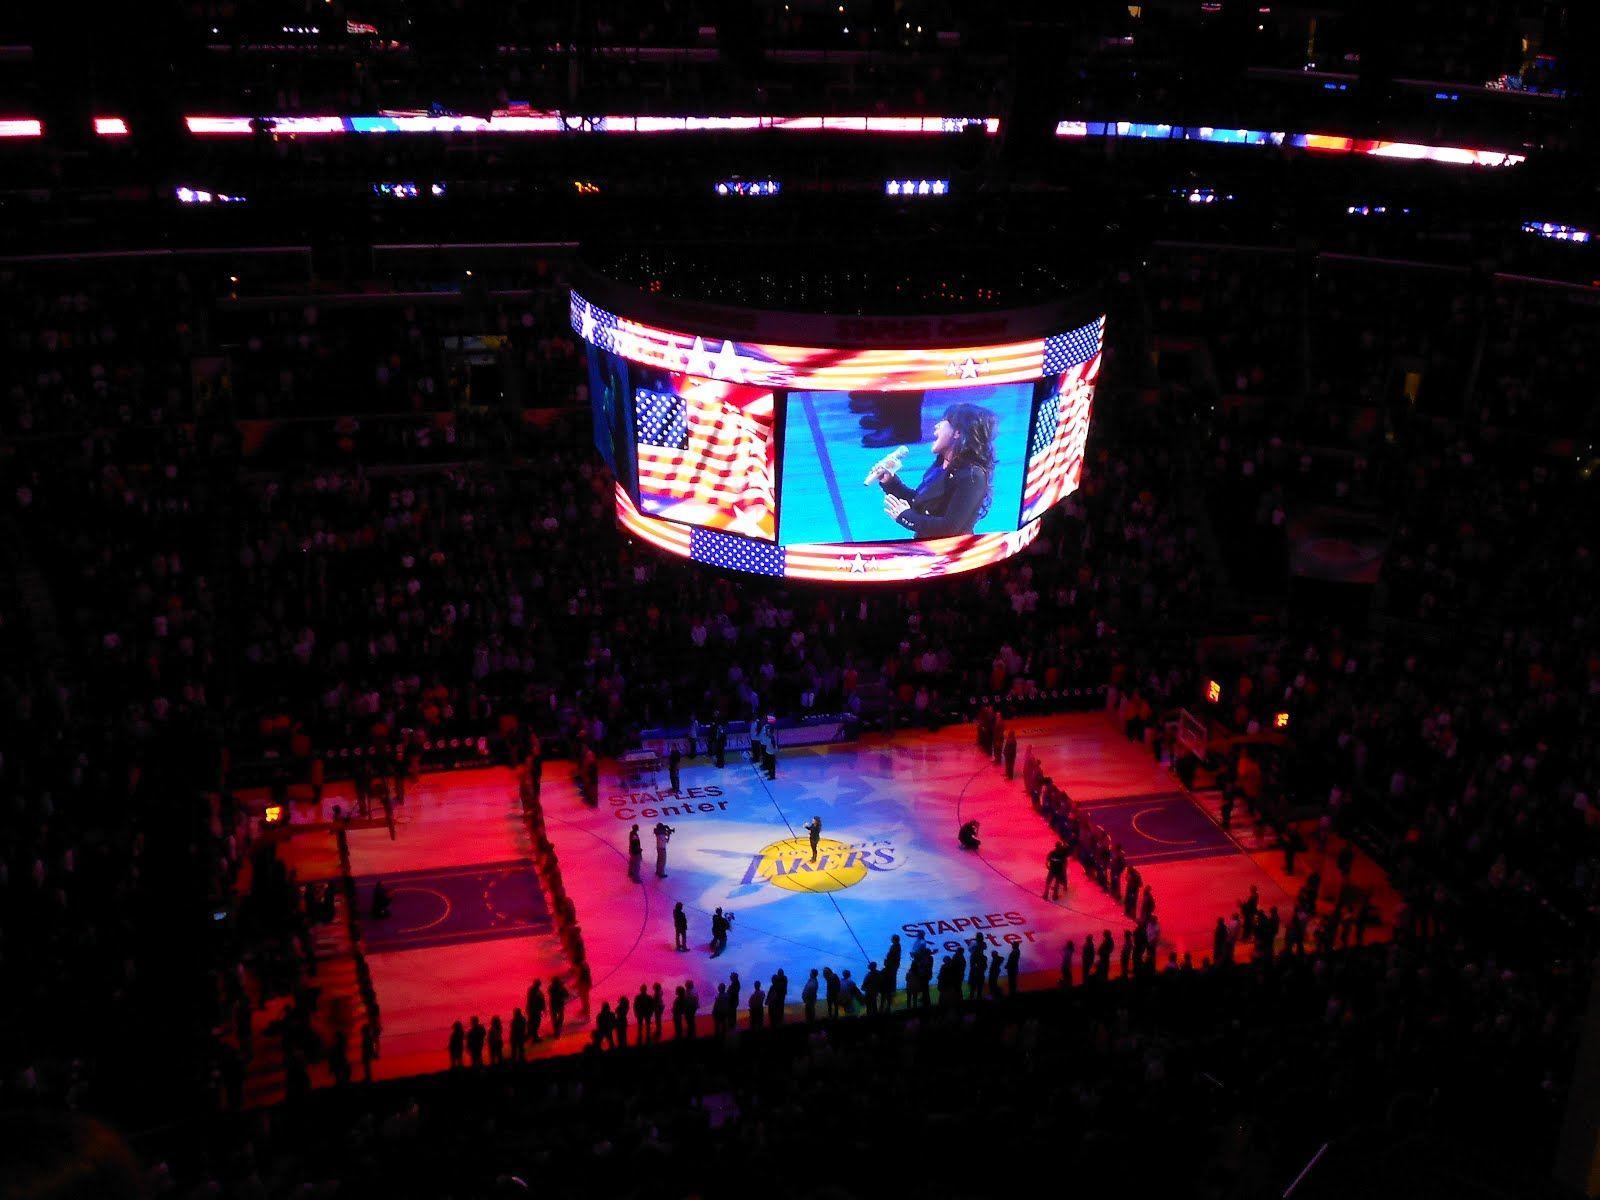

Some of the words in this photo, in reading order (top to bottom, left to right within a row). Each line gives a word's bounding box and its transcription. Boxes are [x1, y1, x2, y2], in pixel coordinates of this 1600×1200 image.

[614, 801, 728, 820] Center
[740, 847, 905, 885] LAKERS
[901, 911, 1026, 938] STAPLES
